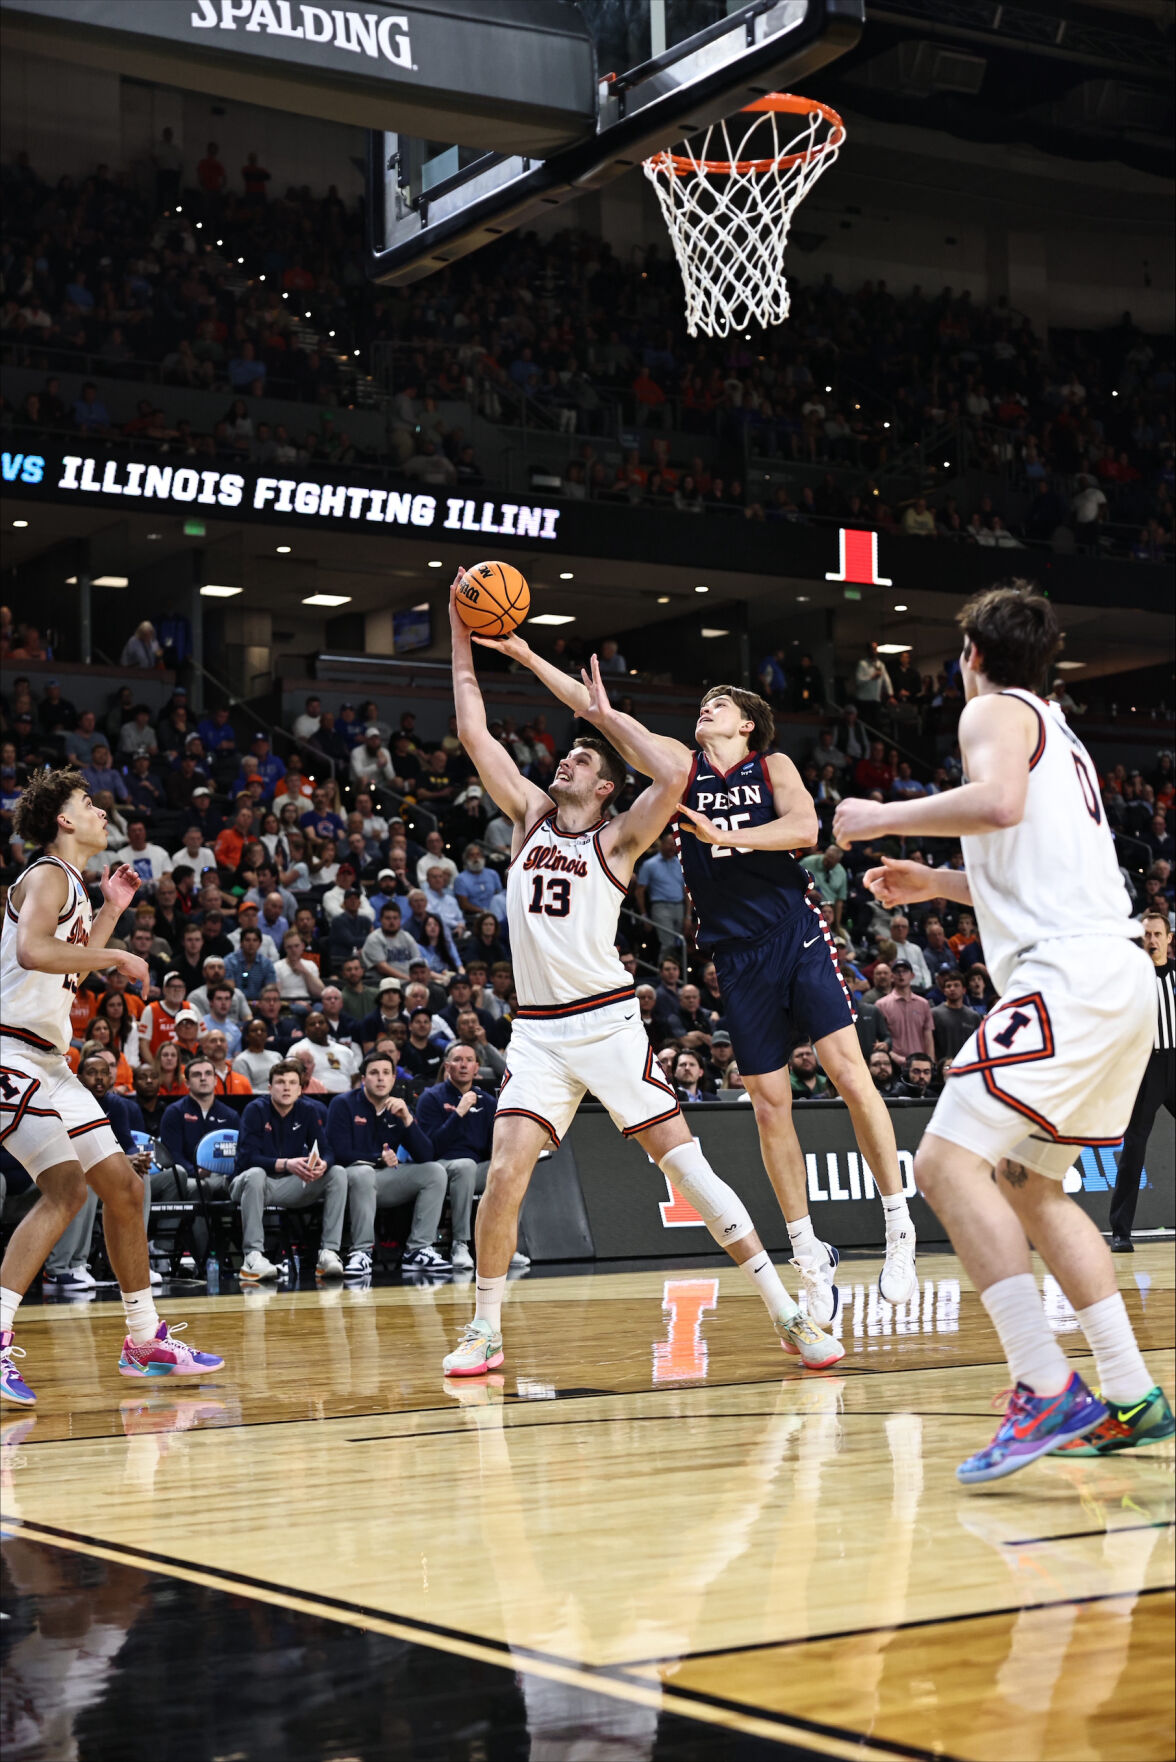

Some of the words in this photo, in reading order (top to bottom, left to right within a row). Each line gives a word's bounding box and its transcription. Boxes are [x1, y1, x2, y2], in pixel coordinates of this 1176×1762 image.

[191, 0, 413, 70] SPALDING
[1, 452, 45, 483] VS
[58, 456, 244, 506] ILLINOIS
[253, 477, 436, 526] FIGHTING
[444, 498, 559, 539] ILLINI
[697, 785, 761, 811] PENN
[1071, 750, 1101, 826] 0
[523, 844, 588, 878] Illinois
[528, 874, 571, 917] 13
